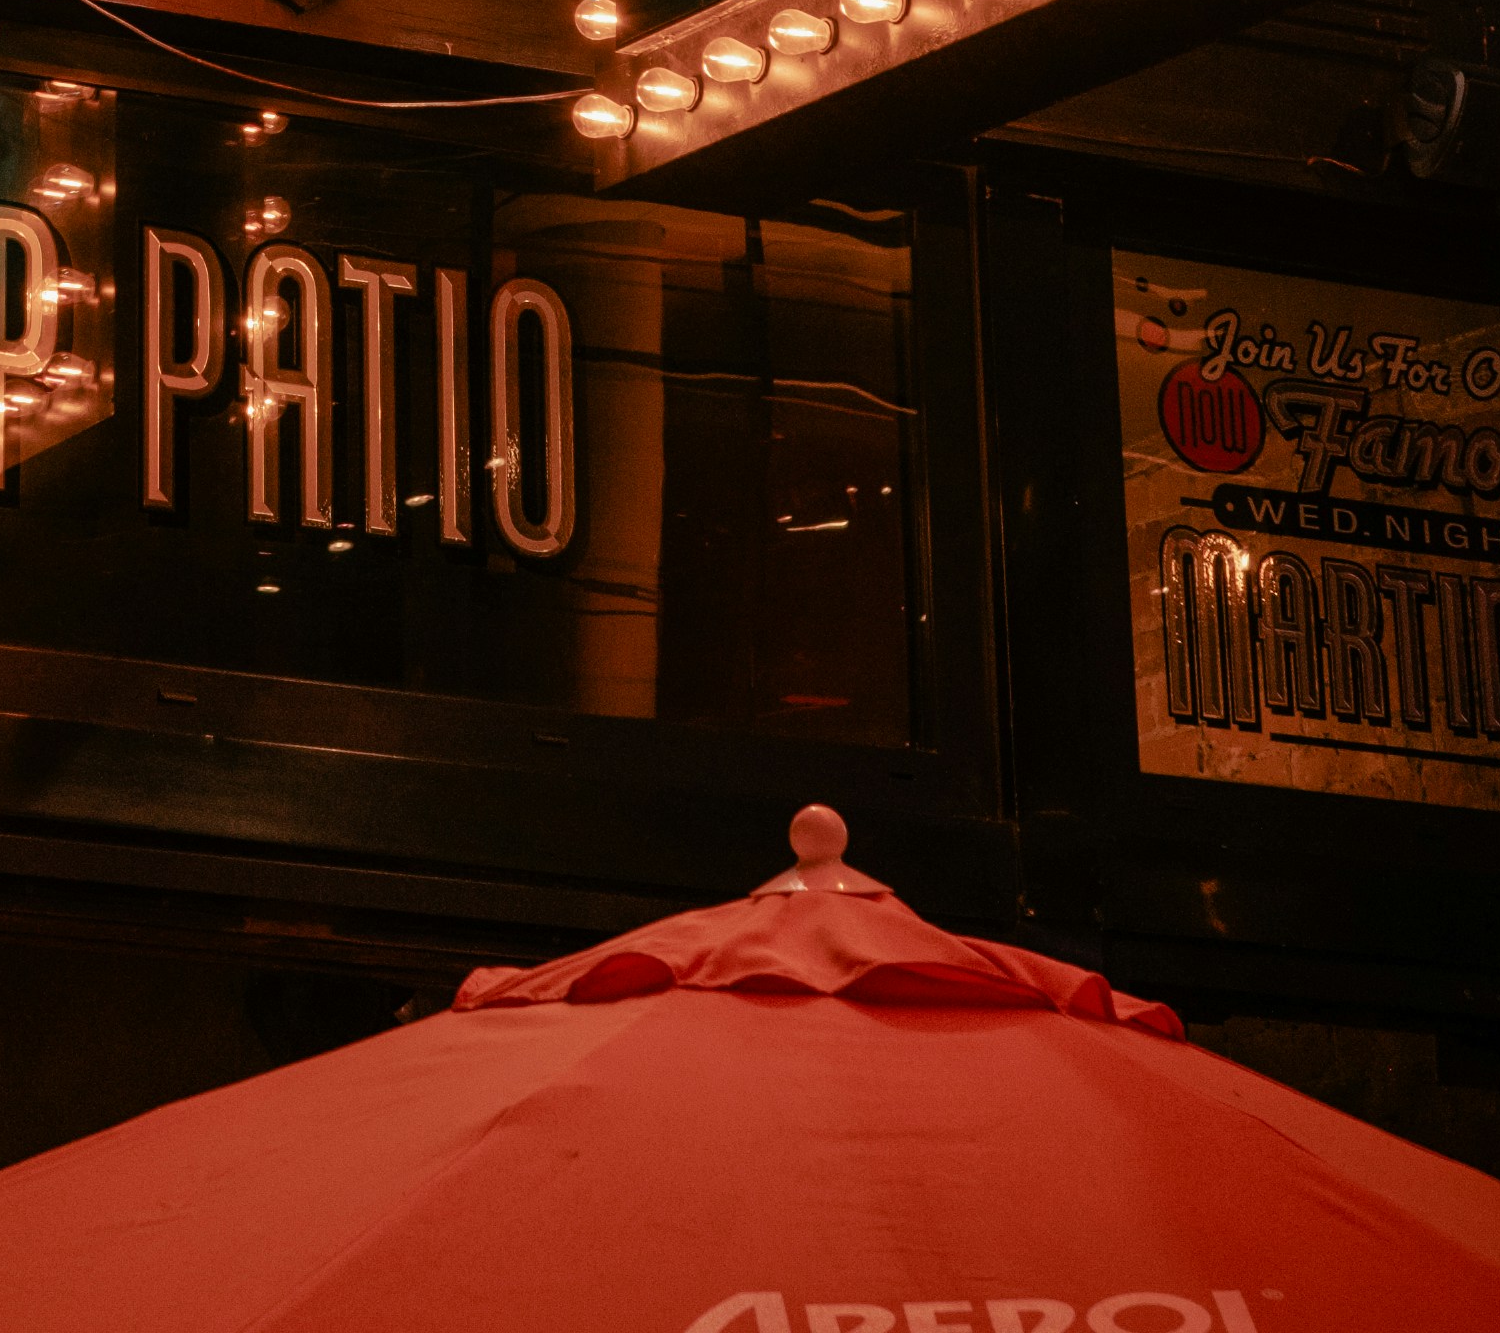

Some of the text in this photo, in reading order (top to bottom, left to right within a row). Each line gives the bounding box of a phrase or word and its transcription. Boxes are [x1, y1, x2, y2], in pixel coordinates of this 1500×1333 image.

[142, 225, 577, 559] PATIO
[1201, 308, 1298, 382] Join
[1307, 321, 1366, 382] Us
[1371, 333, 1450, 398] For
[1245, 494, 1371, 537] WED.
